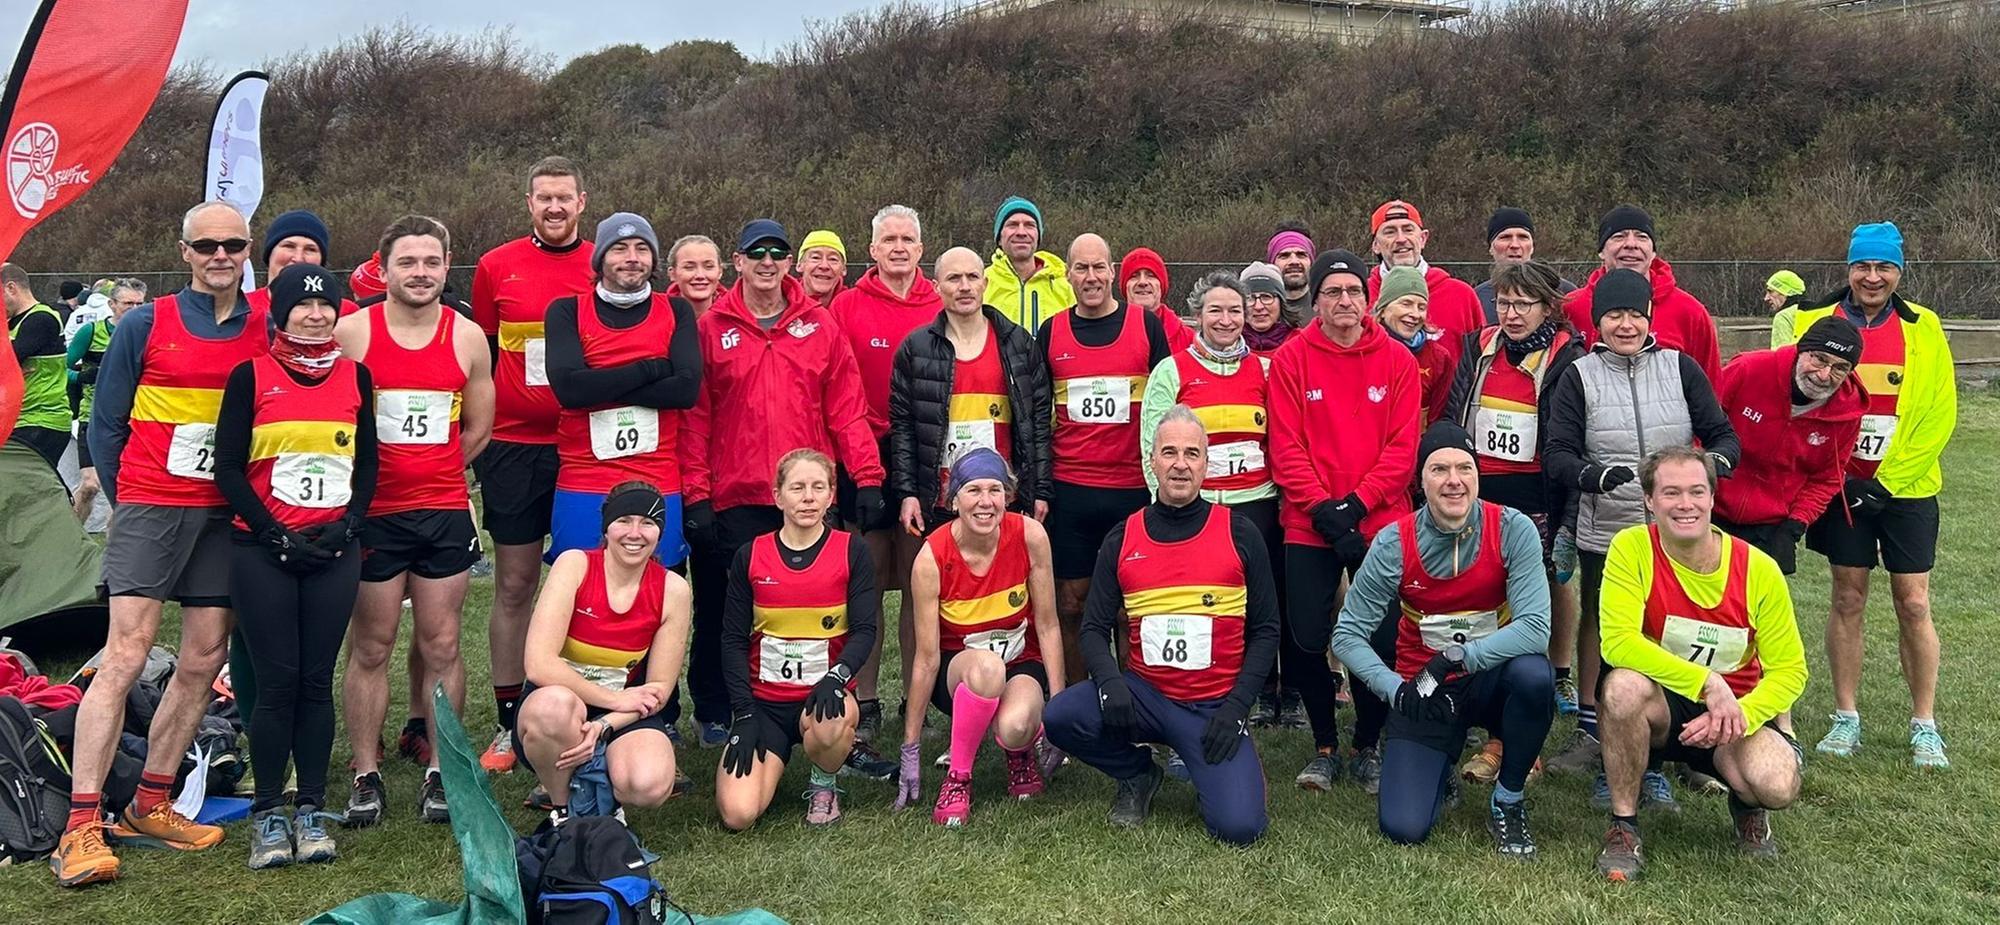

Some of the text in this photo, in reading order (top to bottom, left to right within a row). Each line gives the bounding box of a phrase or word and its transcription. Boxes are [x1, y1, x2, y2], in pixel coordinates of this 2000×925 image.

[721, 334, 740, 349] DF
[871, 338, 890, 348] G.L
[1082, 398, 1116, 417] 850
[1742, 407, 1763, 424] B.H
[401, 415, 428, 437] 45
[615, 428, 639, 451] 69
[1488, 430, 1520, 455] 848
[1229, 459, 1248, 475] 16
[299, 477, 324, 501] 31
[1162, 639, 1188, 663] 68
[1688, 644, 1716, 667] 71
[781, 660, 803, 680] 61
